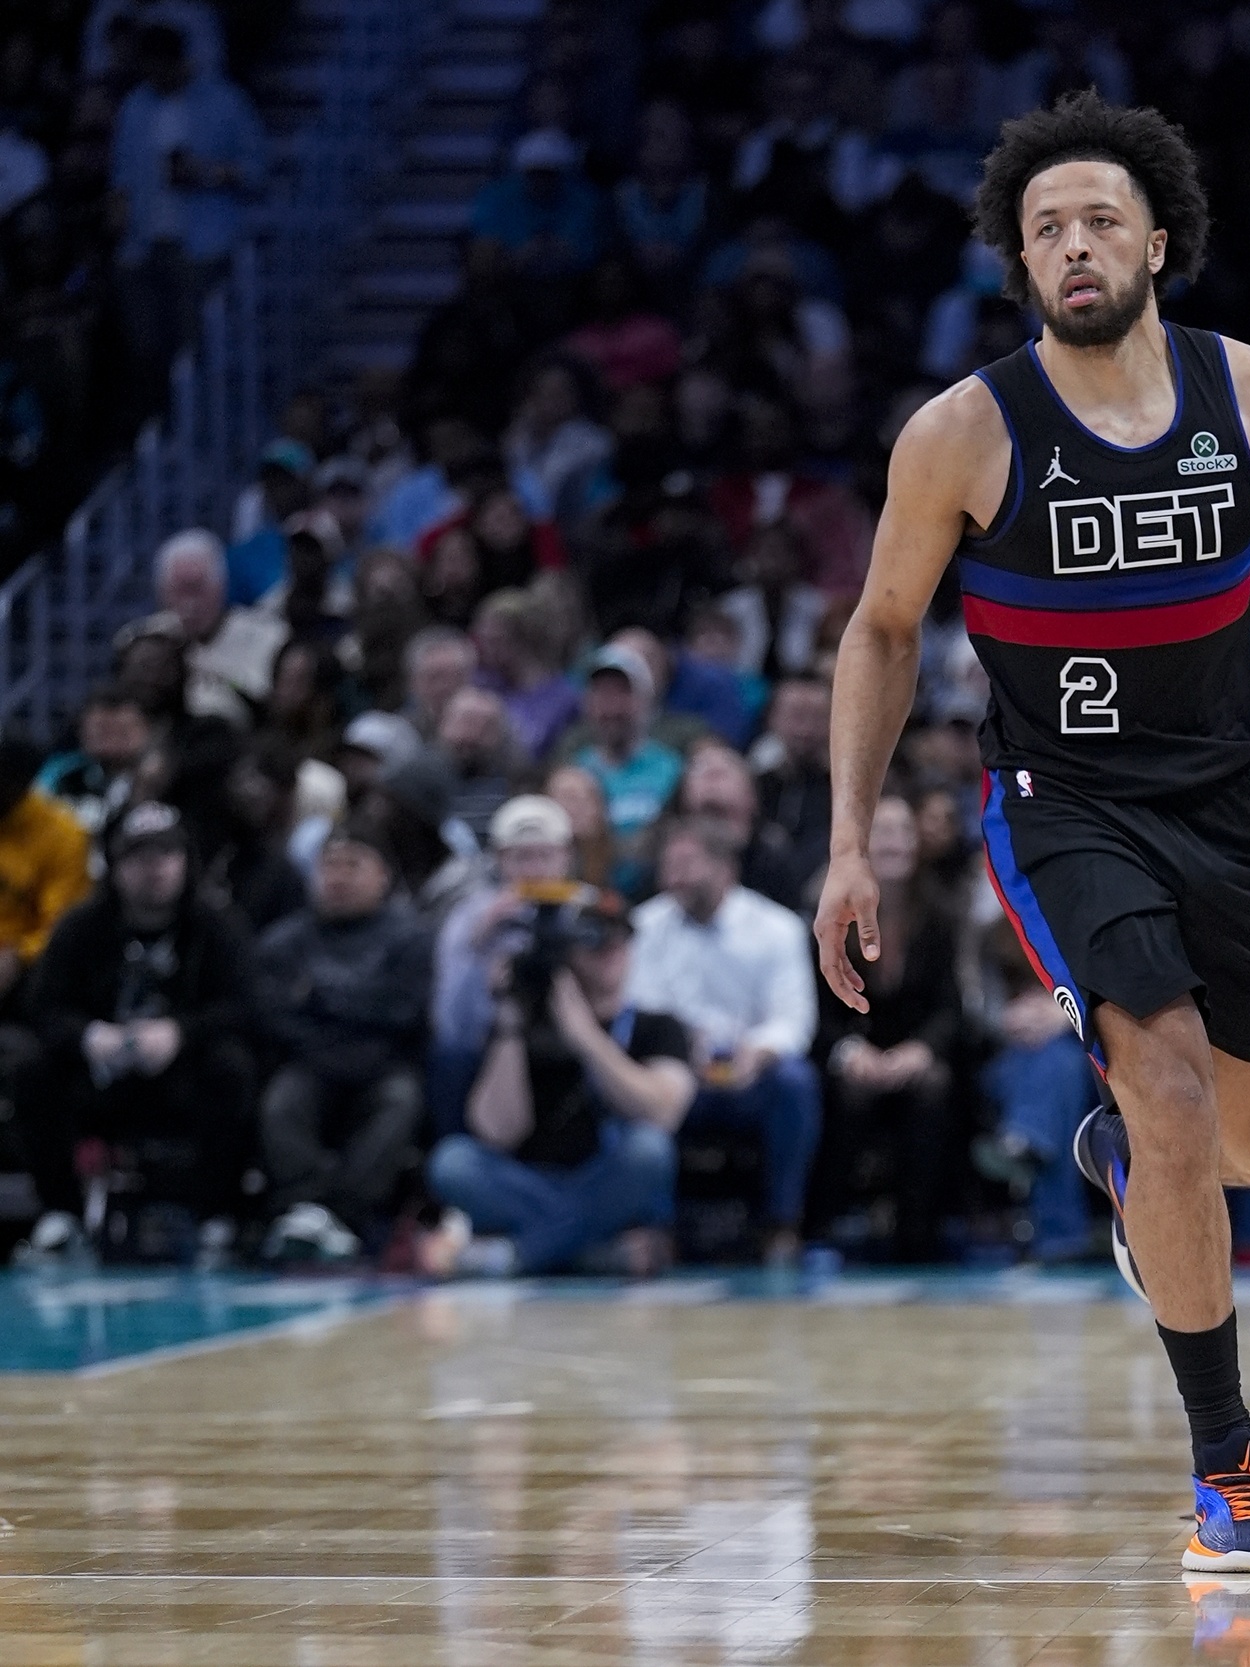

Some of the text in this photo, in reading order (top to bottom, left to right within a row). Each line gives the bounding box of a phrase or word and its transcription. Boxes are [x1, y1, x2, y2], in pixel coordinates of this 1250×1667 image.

[1179, 457, 1236, 473] StockX
[1048, 483, 1235, 575] DET
[1060, 656, 1120, 734] 2
